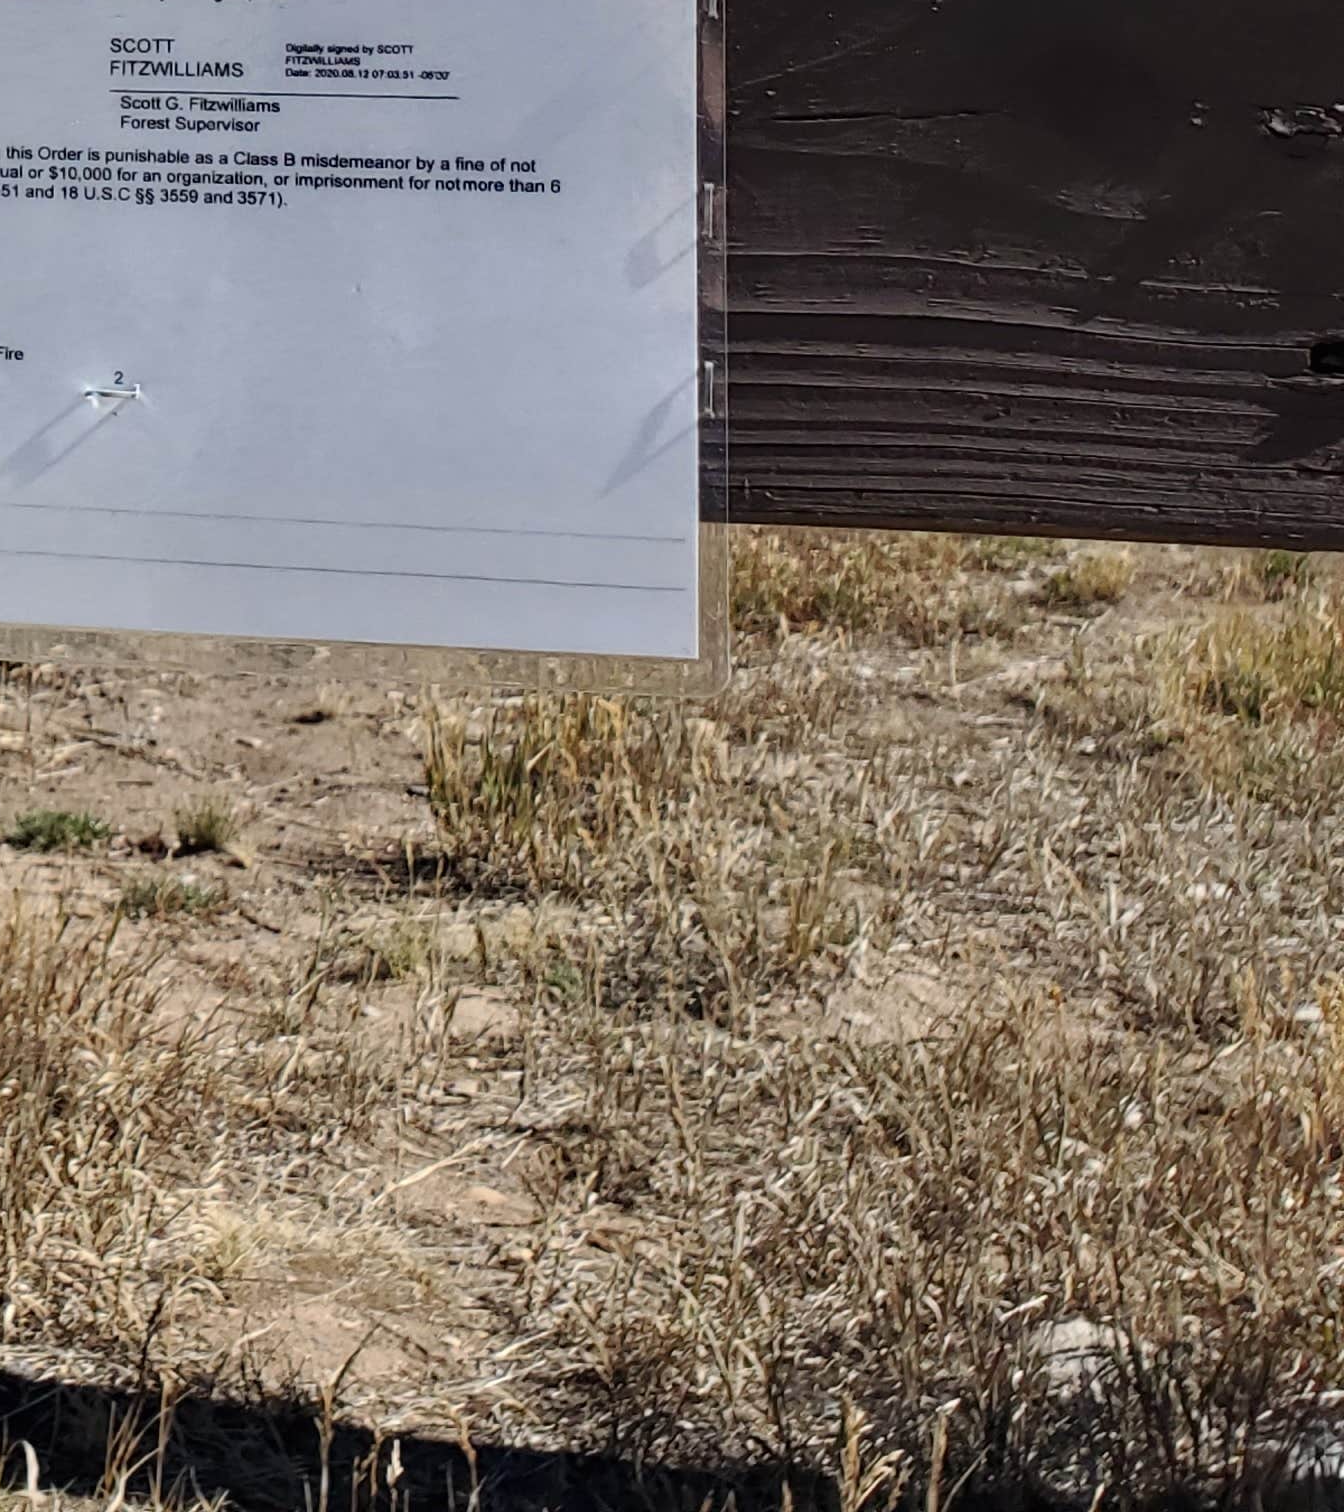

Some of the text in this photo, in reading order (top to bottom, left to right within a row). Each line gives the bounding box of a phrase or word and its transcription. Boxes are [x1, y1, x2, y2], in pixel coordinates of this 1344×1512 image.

[109, 37, 175, 54] SCOTT
[326, 44, 359, 55] signed
[361, 44, 374, 56] by
[376, 44, 413, 54] SCOTT
[110, 59, 244, 78] FITZWILLIAMS
[120, 95, 280, 113] Scott G. Fitzwilliams
[120, 114, 260, 133] Forest Supervisor
[113, 370, 123, 385] 2
